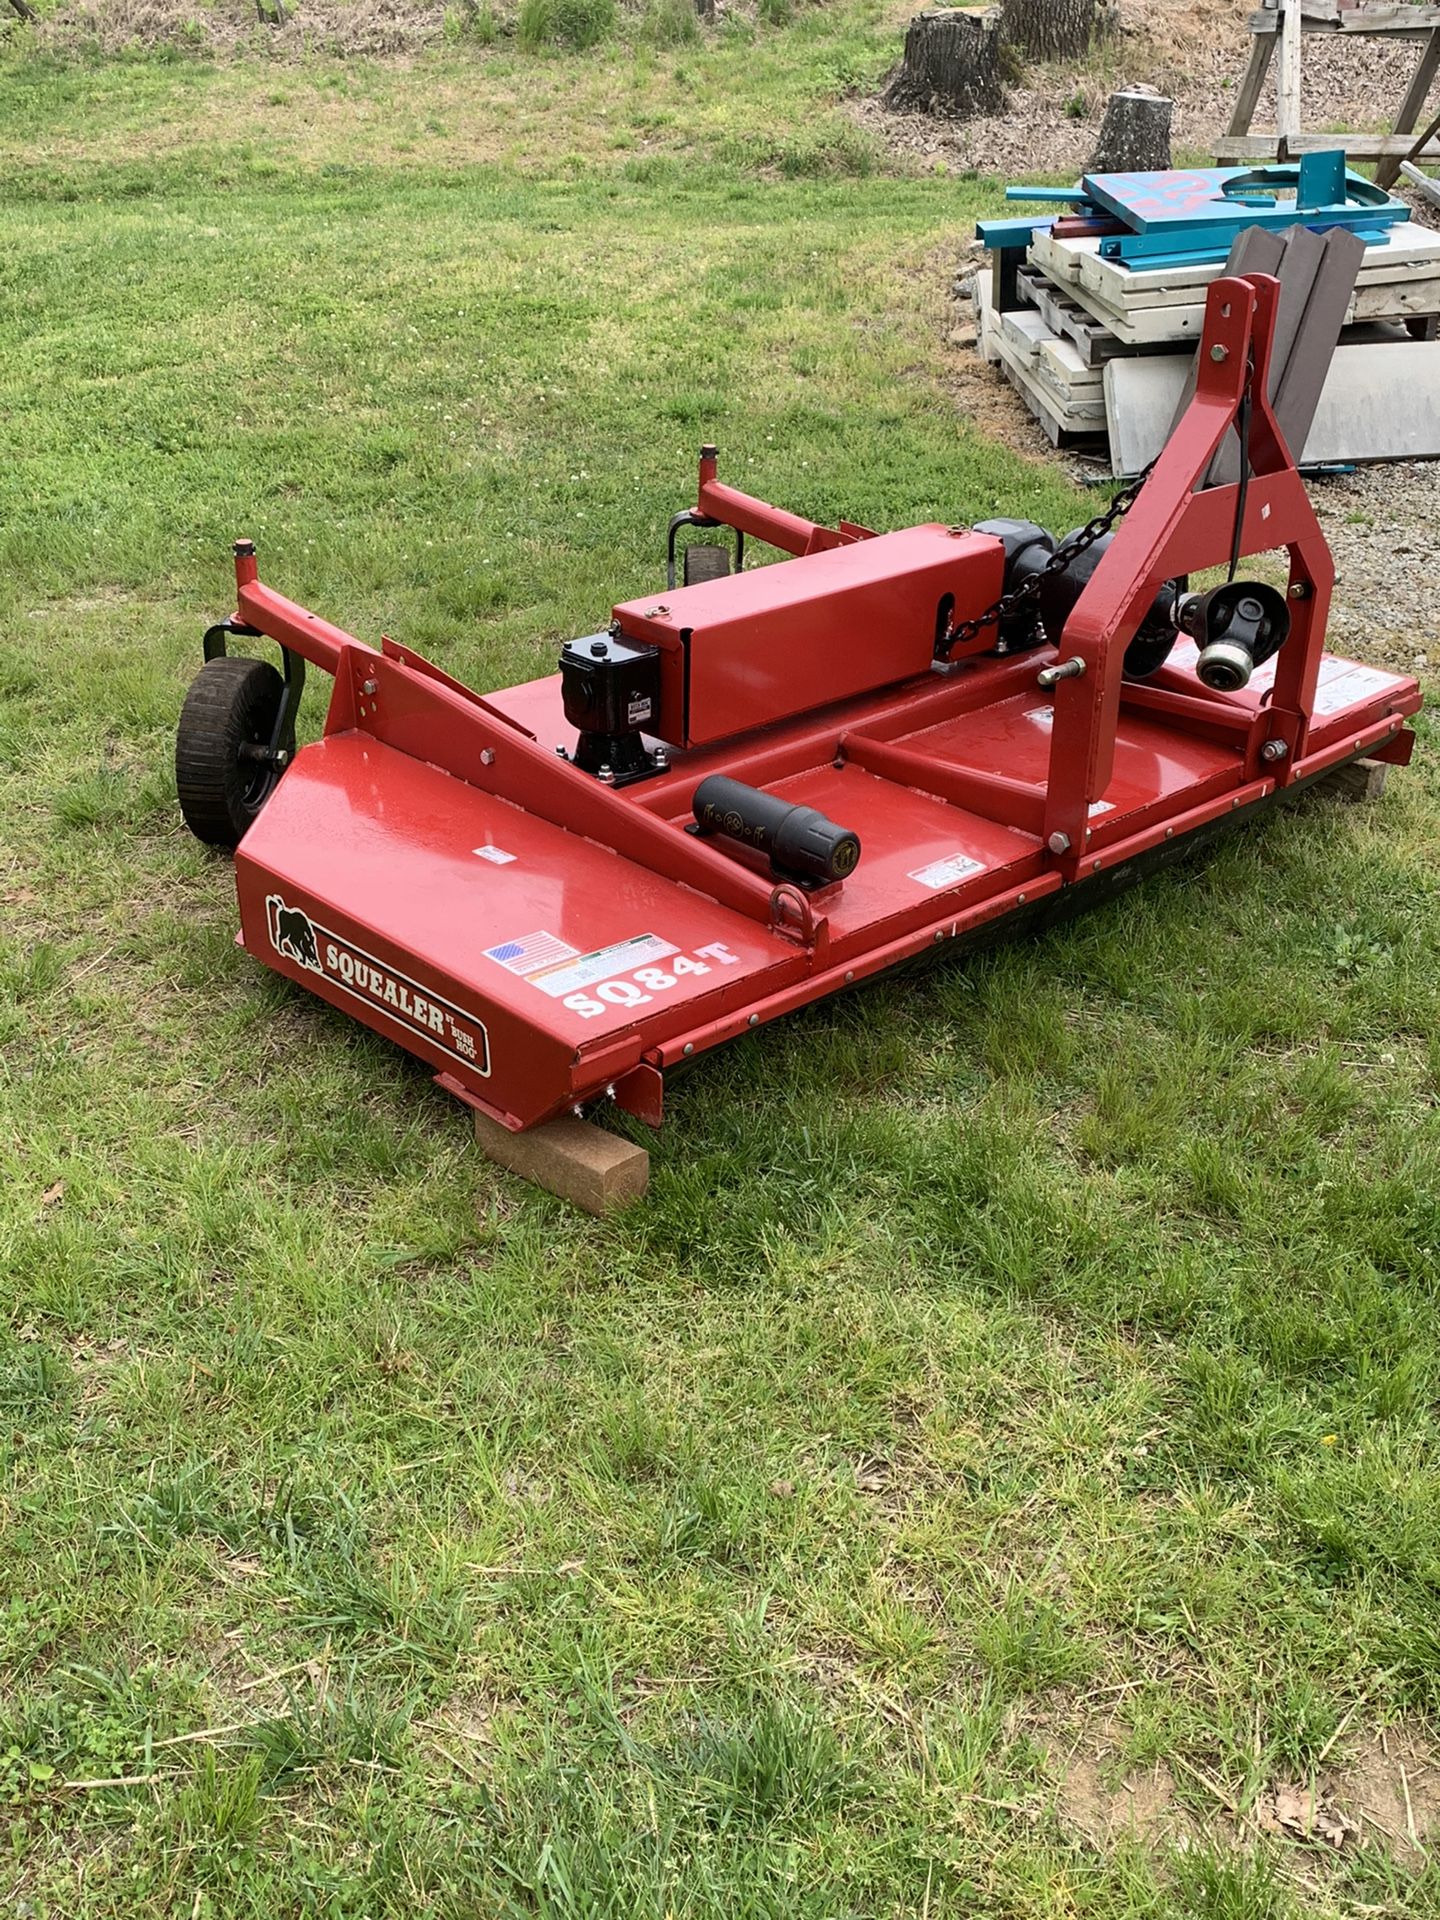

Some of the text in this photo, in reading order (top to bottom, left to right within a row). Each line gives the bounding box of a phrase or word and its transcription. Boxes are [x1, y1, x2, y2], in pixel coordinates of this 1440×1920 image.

[327, 944, 444, 1035] SQUEALER
[563, 942, 740, 1019] SQ84T
[451, 1025, 474, 1048] BUSH
